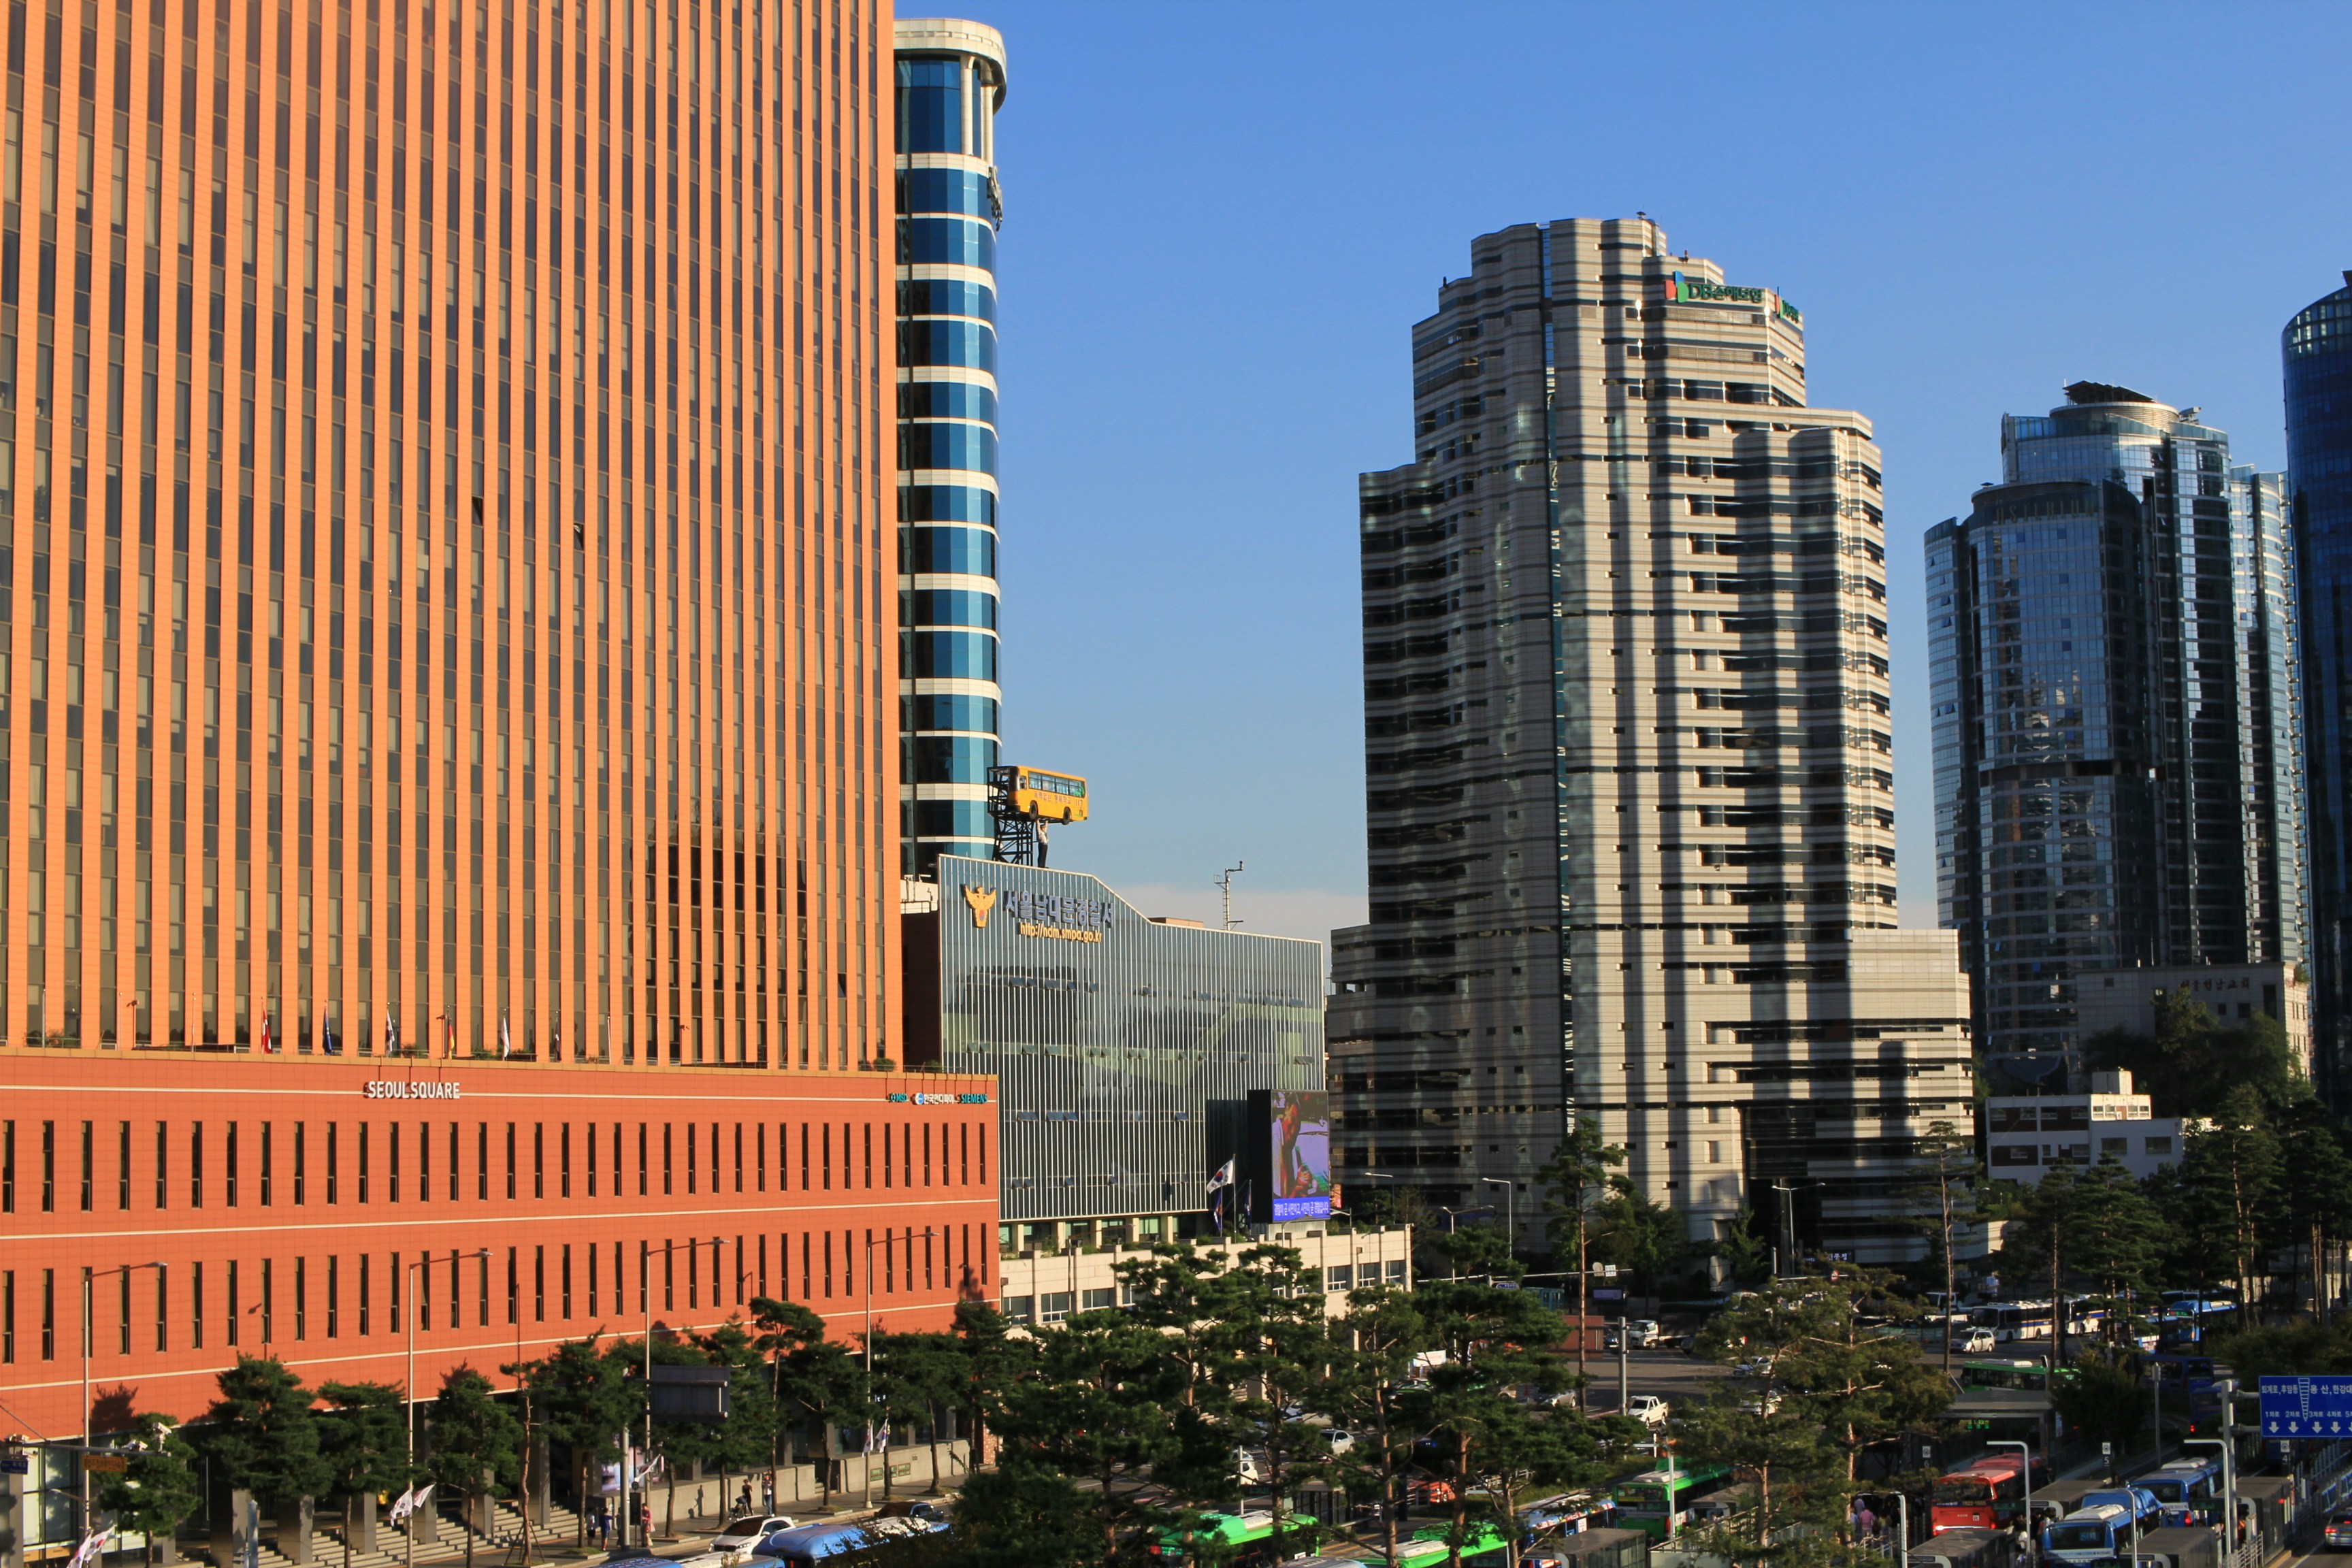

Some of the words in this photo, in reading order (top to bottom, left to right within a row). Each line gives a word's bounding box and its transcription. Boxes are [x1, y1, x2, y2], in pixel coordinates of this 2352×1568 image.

[1689, 283, 1763, 303] DB손해보험
[1005, 889, 1114, 928] 서울남대문경찰서
[1019, 921, 1102, 943] http://ndm.smpa.go.kr
[368, 1081, 410, 1098] SEOUL
[410, 1081, 461, 1099] SQUARE
[961, 1094, 987, 1104] SIEMENS
[1924, 1459, 1929, 1468] 6
[2104, 1456, 2109, 1465] 5
[2282, 1454, 2287, 1463] 4
